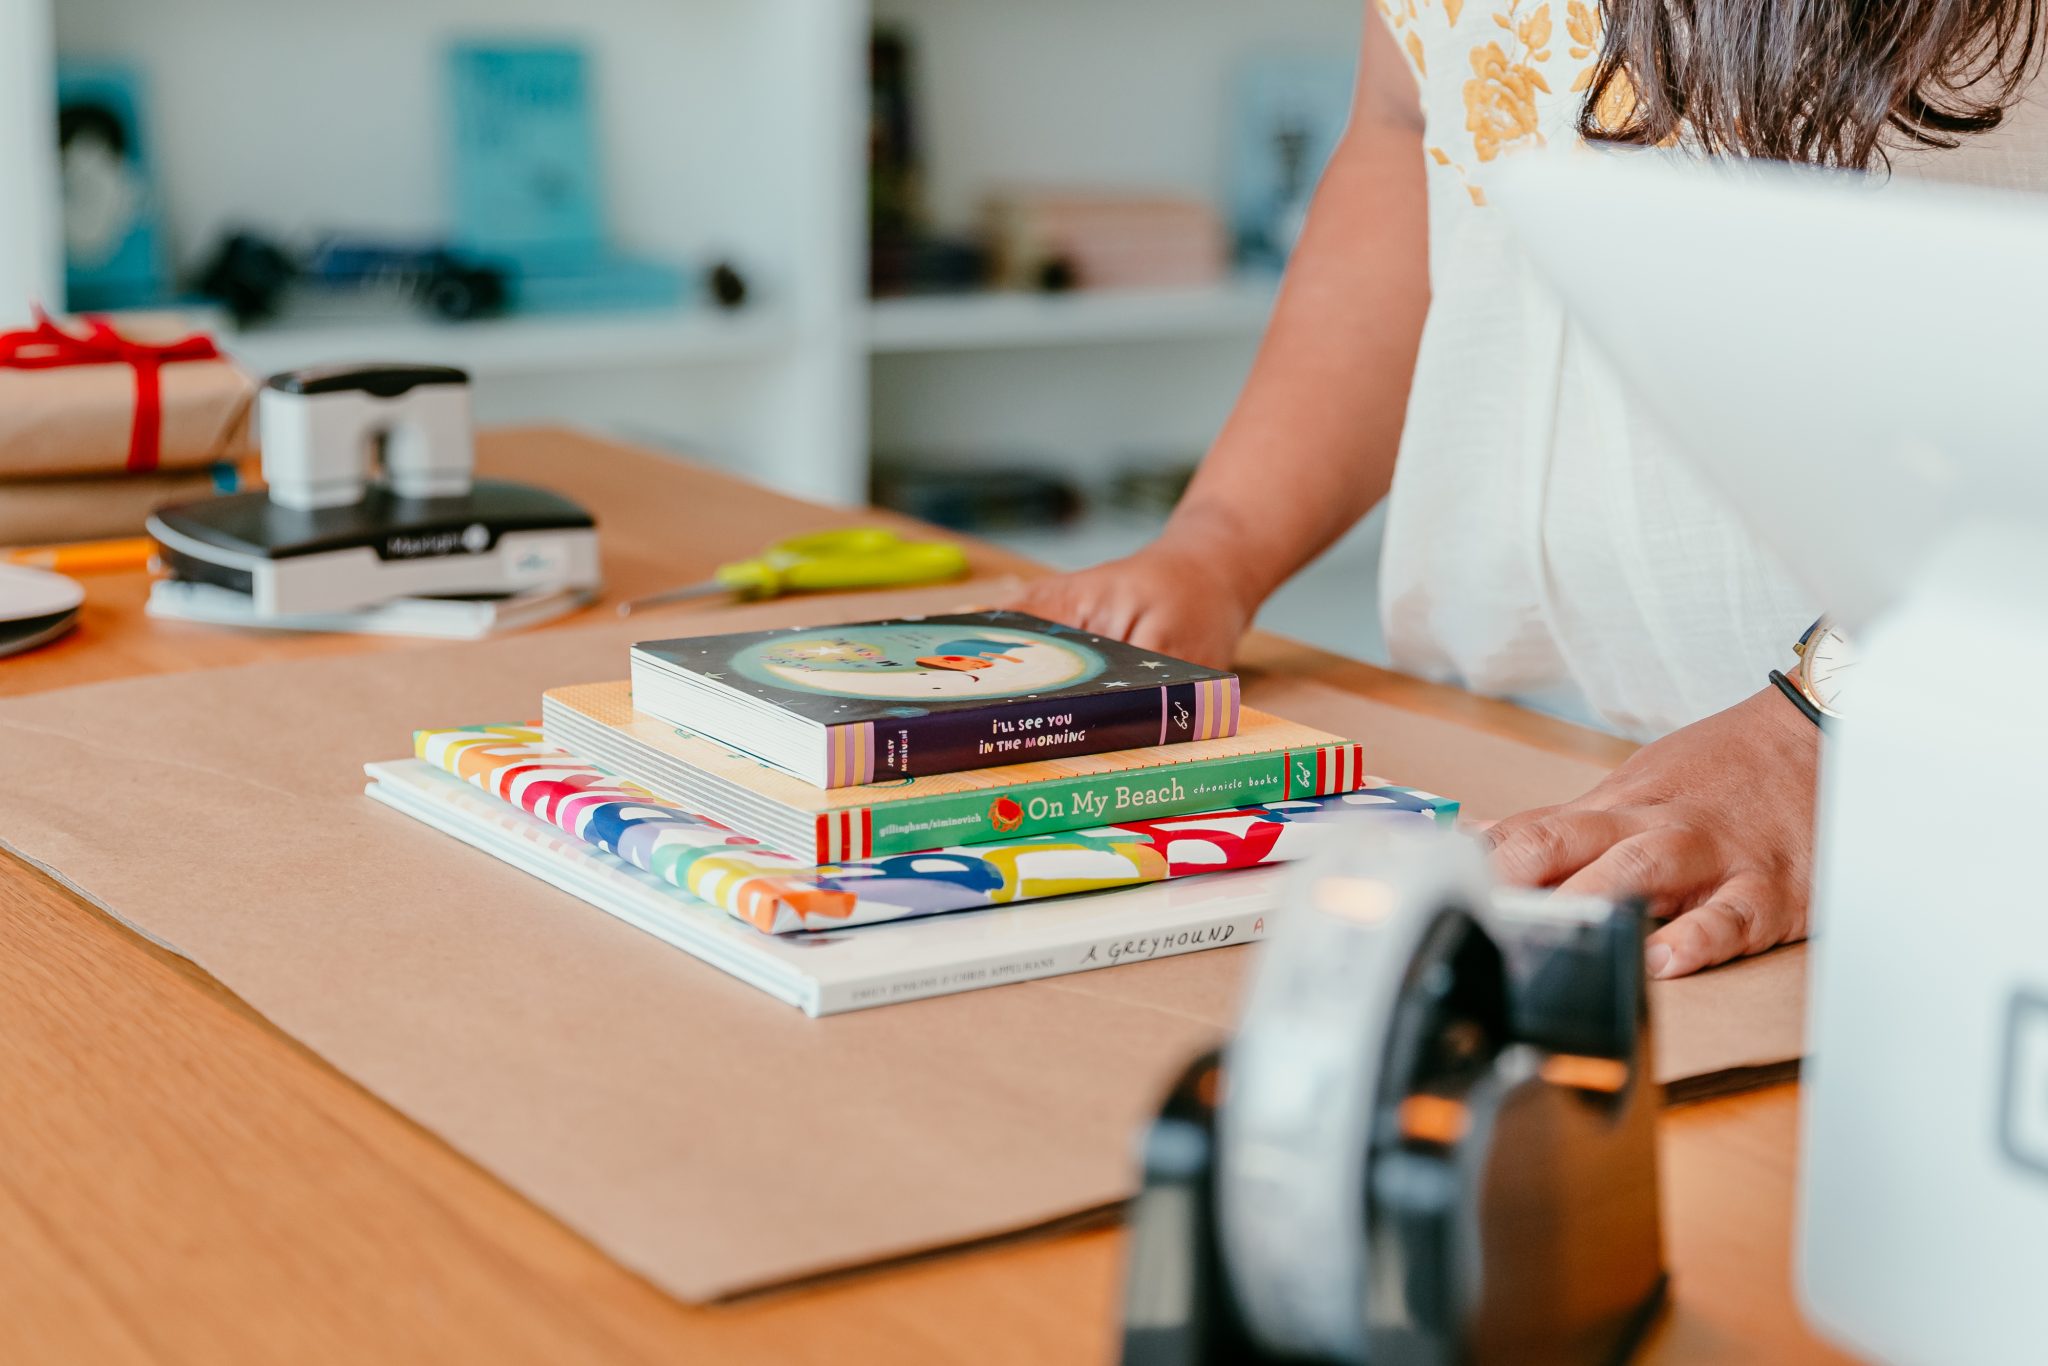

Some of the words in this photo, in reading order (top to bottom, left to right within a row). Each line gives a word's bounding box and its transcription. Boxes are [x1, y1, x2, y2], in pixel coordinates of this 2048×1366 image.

[1047, 713, 1073, 727] YOU
[1028, 797, 1064, 821] On
[1071, 790, 1109, 818] My
[1115, 777, 1186, 809] Beach
[1193, 778, 1243, 794] chronicle
[1248, 773, 1279, 787] books
[1108, 924, 1236, 965] GREYHOUND
[1253, 916, 1266, 935] A
